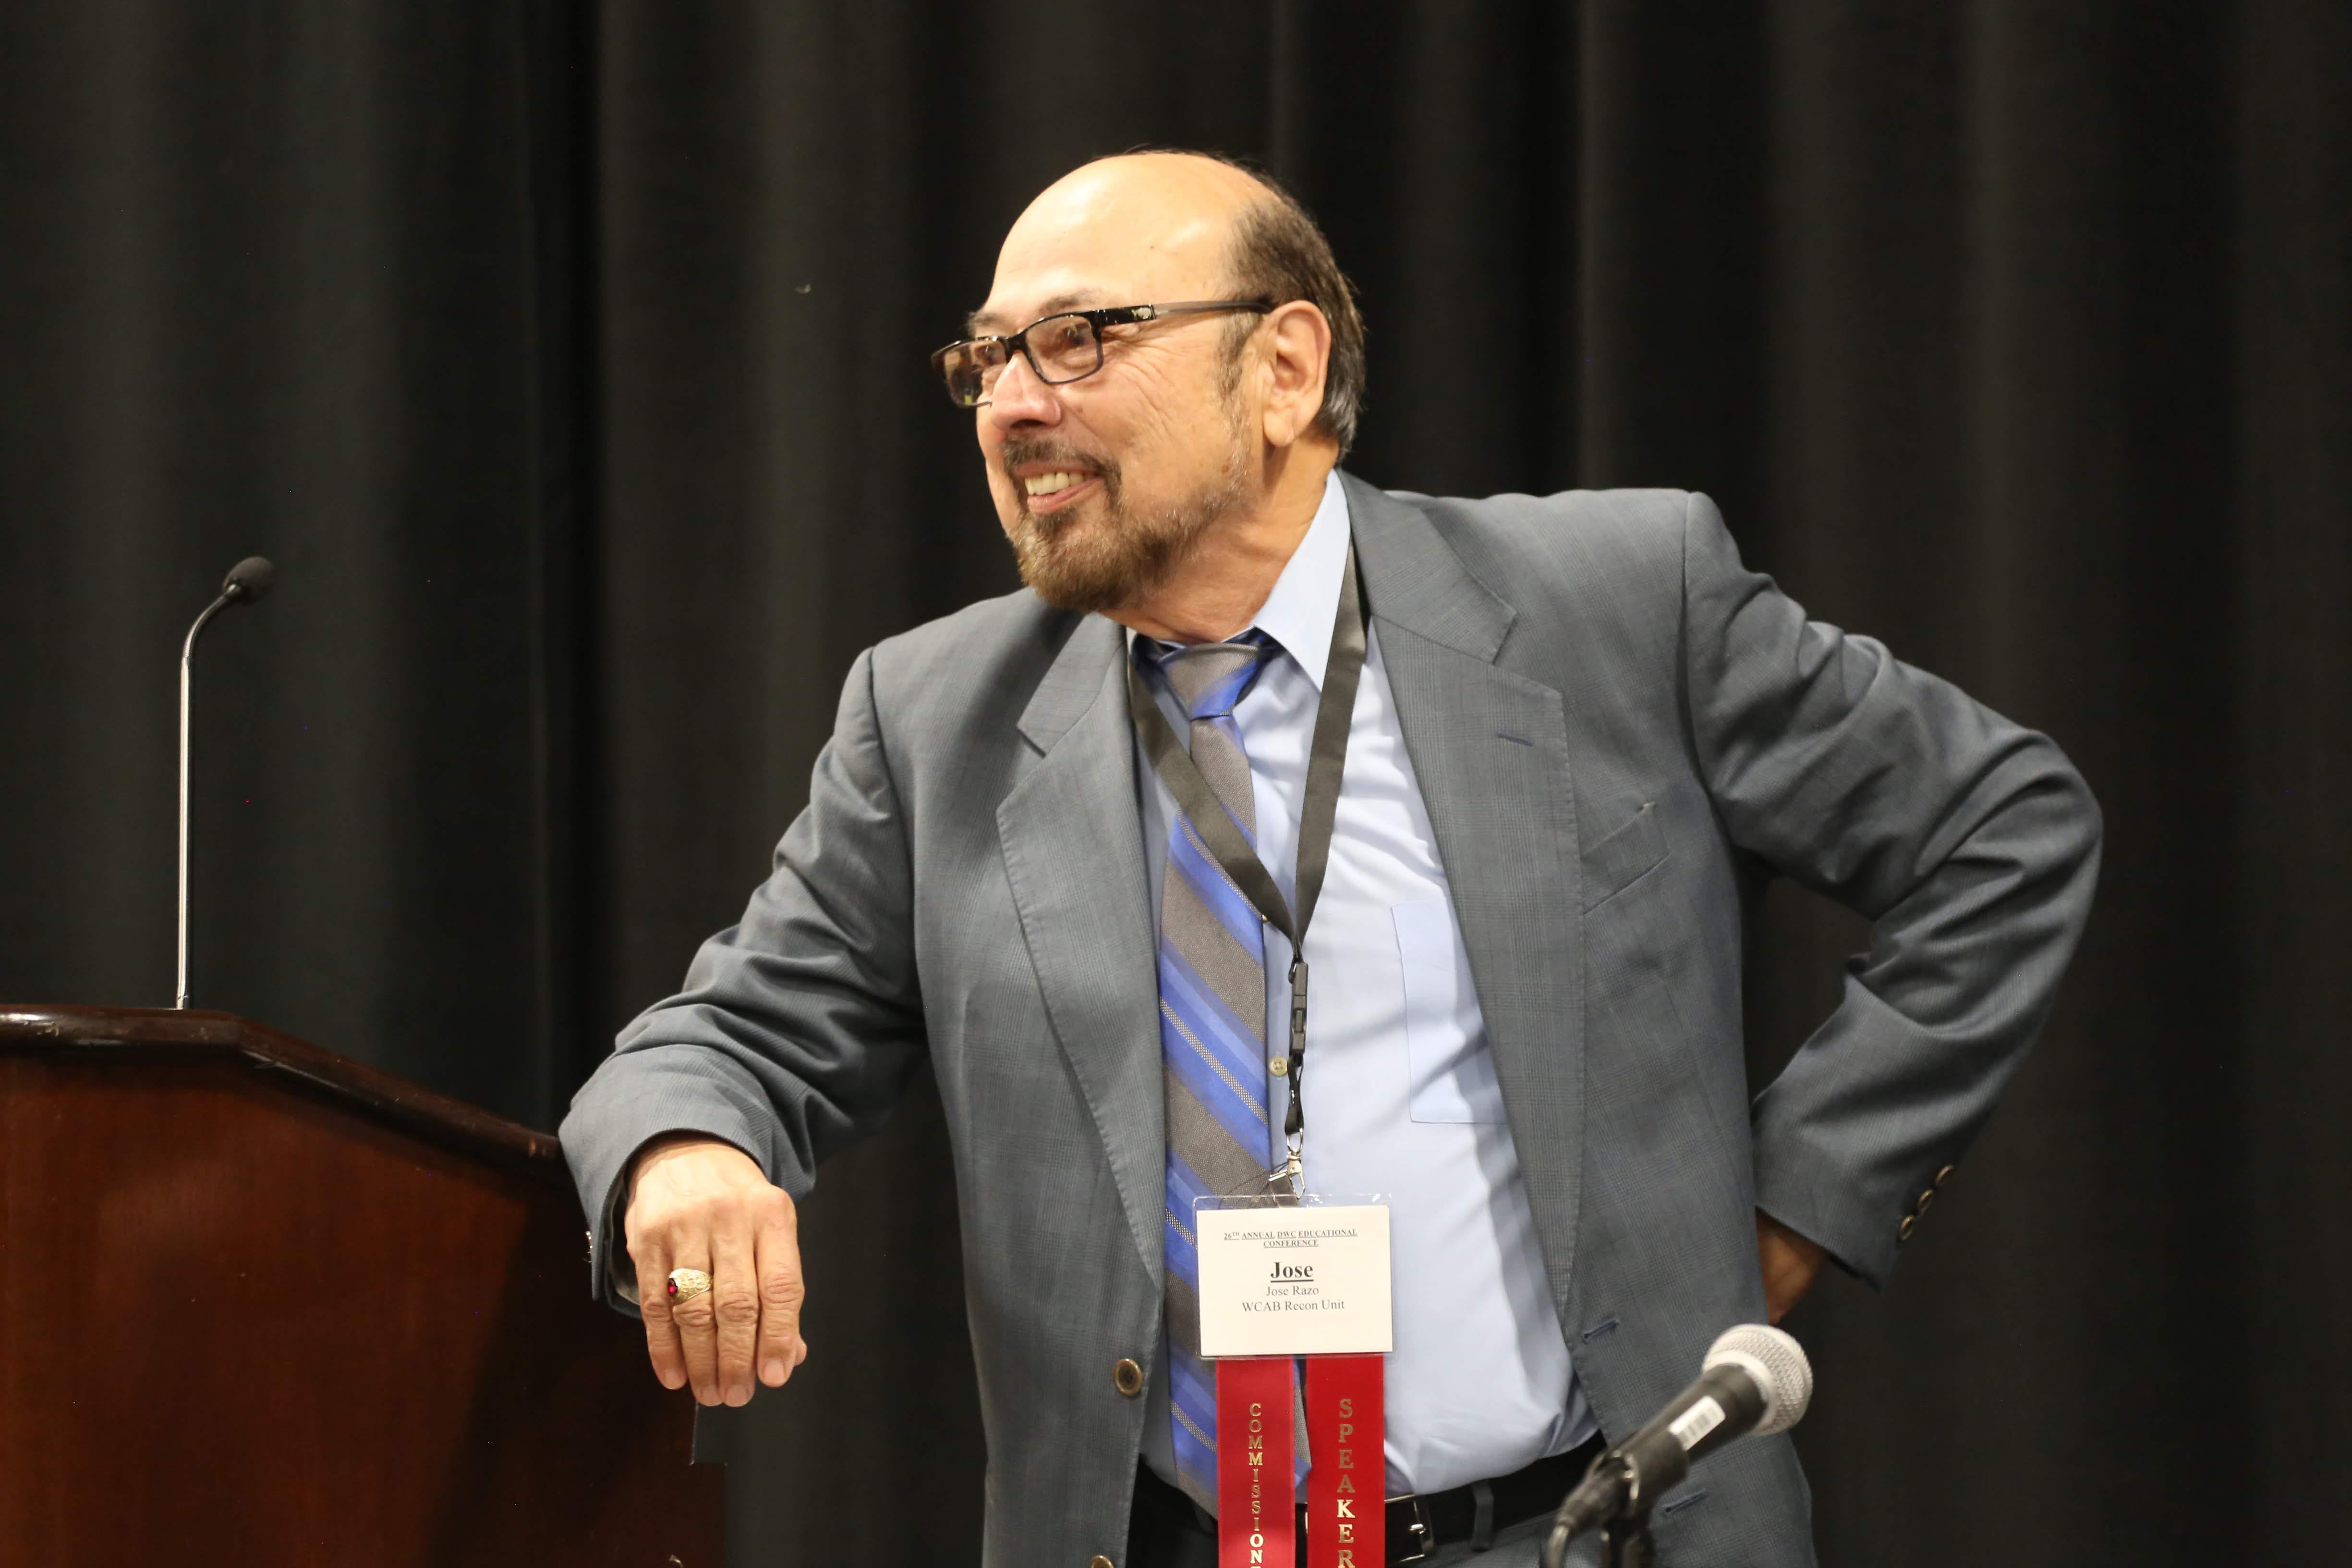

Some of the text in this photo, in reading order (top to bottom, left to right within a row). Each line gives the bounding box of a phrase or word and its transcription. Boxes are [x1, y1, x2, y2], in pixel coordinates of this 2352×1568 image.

[1241, 1231, 1275, 1240] ANNUAL
[1277, 1230, 1297, 1239] DWC
[1298, 1229, 1358, 1238] EDUCATIONAL
[1263, 1240, 1319, 1248] CONFERENCE
[1270, 1262, 1314, 1279] Jose
[1266, 1285, 1319, 1296] Jose Razo
[1242, 1299, 1345, 1312] WCAB Recon Unit
[1249, 1402, 1264, 1568] COMMISSION
[1336, 1398, 1356, 1568] SPEAKER
